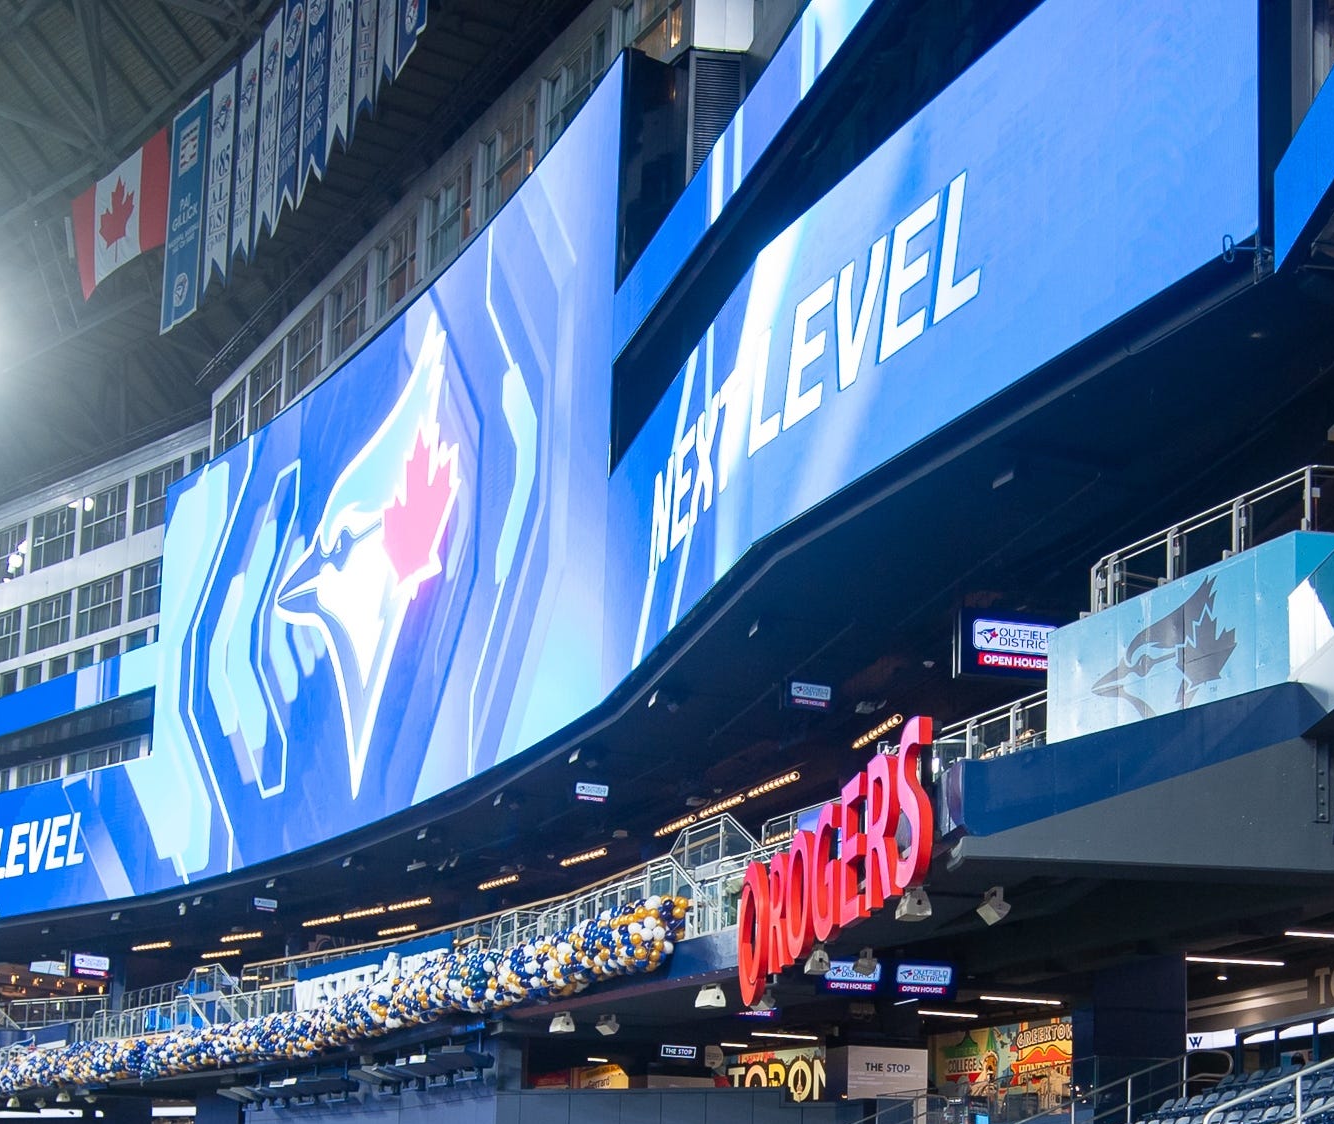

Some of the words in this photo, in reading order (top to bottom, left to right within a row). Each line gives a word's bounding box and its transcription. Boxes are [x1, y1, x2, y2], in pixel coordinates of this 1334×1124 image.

[747, 169, 982, 458] LEVEL
[999, 627, 1048, 640] OUTFIEL
[999, 638, 1048, 650] DISTRIC
[983, 655, 1013, 667] OPEN
[1013, 657, 1048, 669] HOUSE
[768, 716, 933, 974] ROGERS
[912, 974, 947, 982] DISTRICT
[665, 1047, 677, 1055] THE
[677, 1048, 694, 1056] STOP
[865, 1062, 884, 1072] THE
[886, 1063, 911, 1073] STOP
[947, 1057, 977, 1073] COLLEGE
